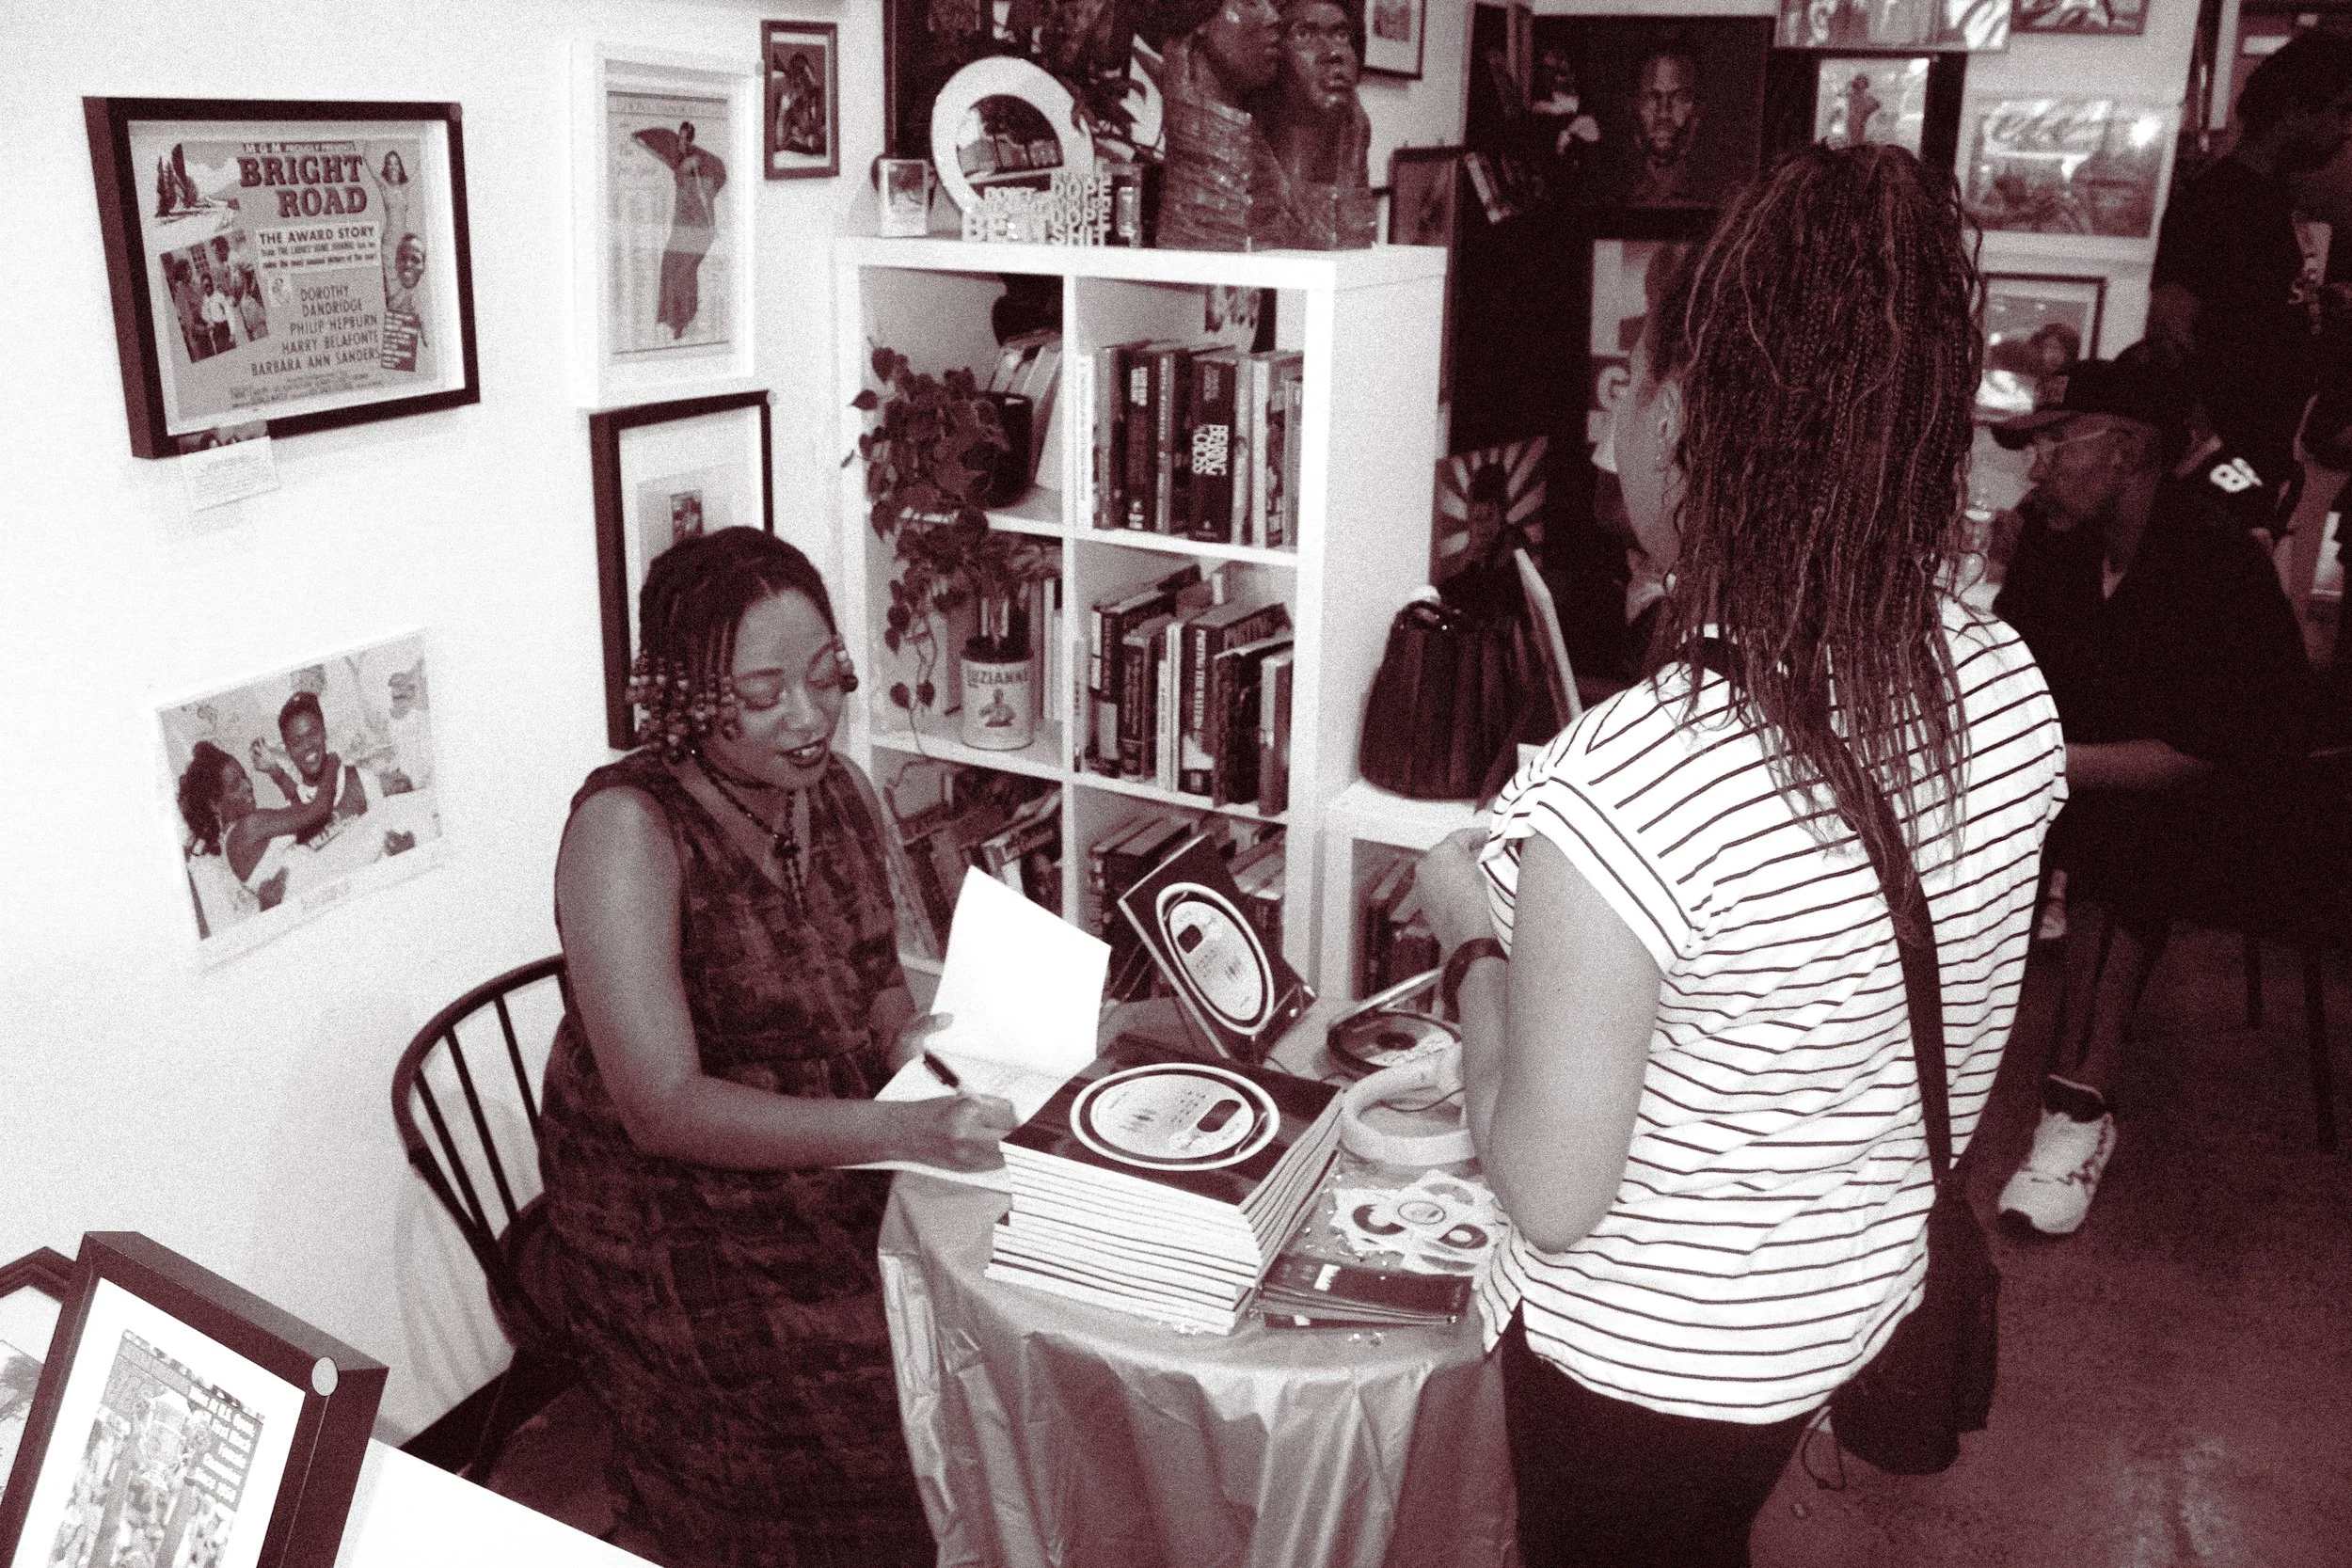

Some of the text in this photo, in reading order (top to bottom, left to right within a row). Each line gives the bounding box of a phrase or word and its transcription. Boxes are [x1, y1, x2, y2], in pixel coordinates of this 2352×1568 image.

[237, 154, 363, 187] BRIGHT
[1051, 179, 1111, 198] DOPE
[276, 185, 367, 218] ROAD
[1051, 206, 1111, 226] DOPE
[260, 226, 374, 245] THE AWARD STORY
[1051, 224, 1110, 245] SHIT
[299, 285, 349, 302] DOROTHY
[301, 297, 363, 318] DANDRIDGE
[290, 313, 377, 337] PHILIP HEPBURN
[282, 330, 379, 355] HARRY BELAFONTE
[250, 358, 302, 377] BARBARA
[308, 354, 331, 369] ANN
[1191, 433, 1211, 474] CROSS
[1205, 424, 1229, 476] BEARING
[1196, 670, 1206, 689] THE
